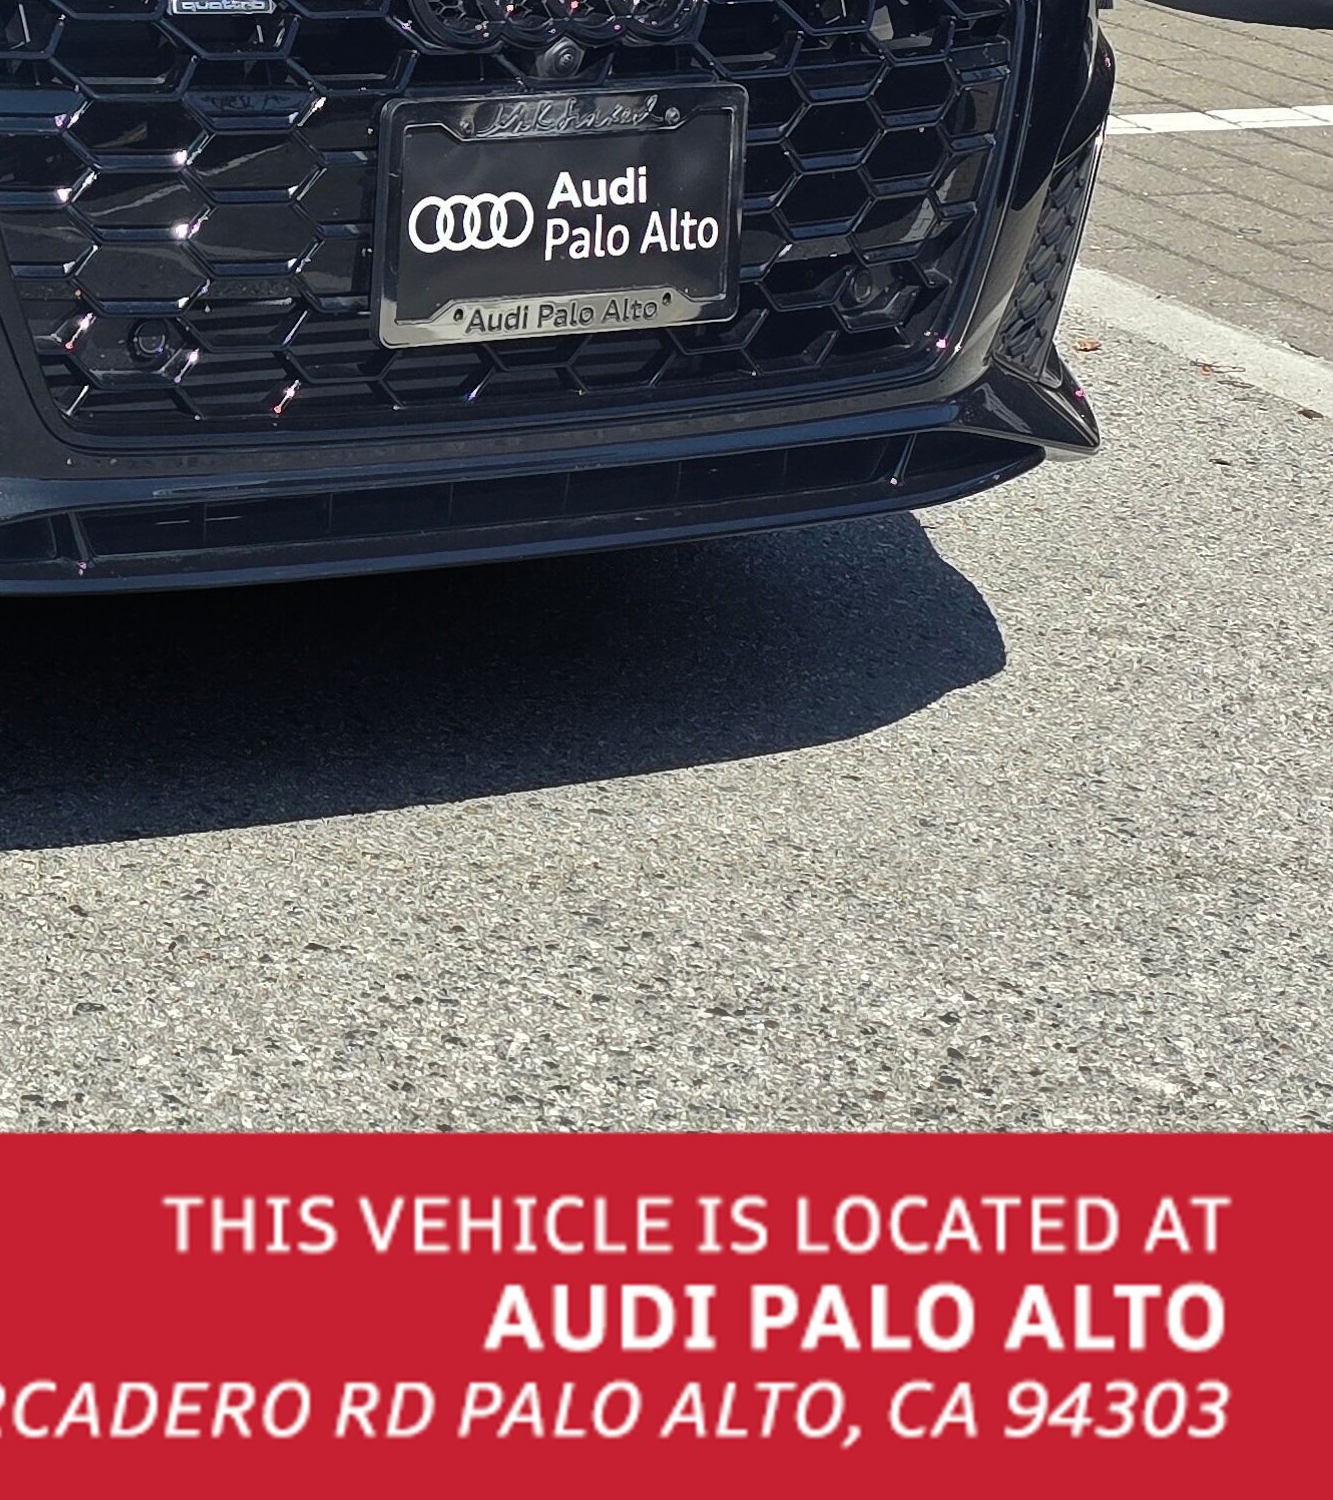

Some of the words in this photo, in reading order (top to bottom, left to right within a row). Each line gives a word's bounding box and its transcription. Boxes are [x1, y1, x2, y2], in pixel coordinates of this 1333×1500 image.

[181, 0, 265, 12] quattro
[546, 165, 648, 210] Audi
[544, 213, 631, 262] Palo
[639, 207, 720, 255] Alto
[464, 305, 530, 335] Audi
[536, 301, 595, 329] Palo
[600, 297, 658, 324] Alto
